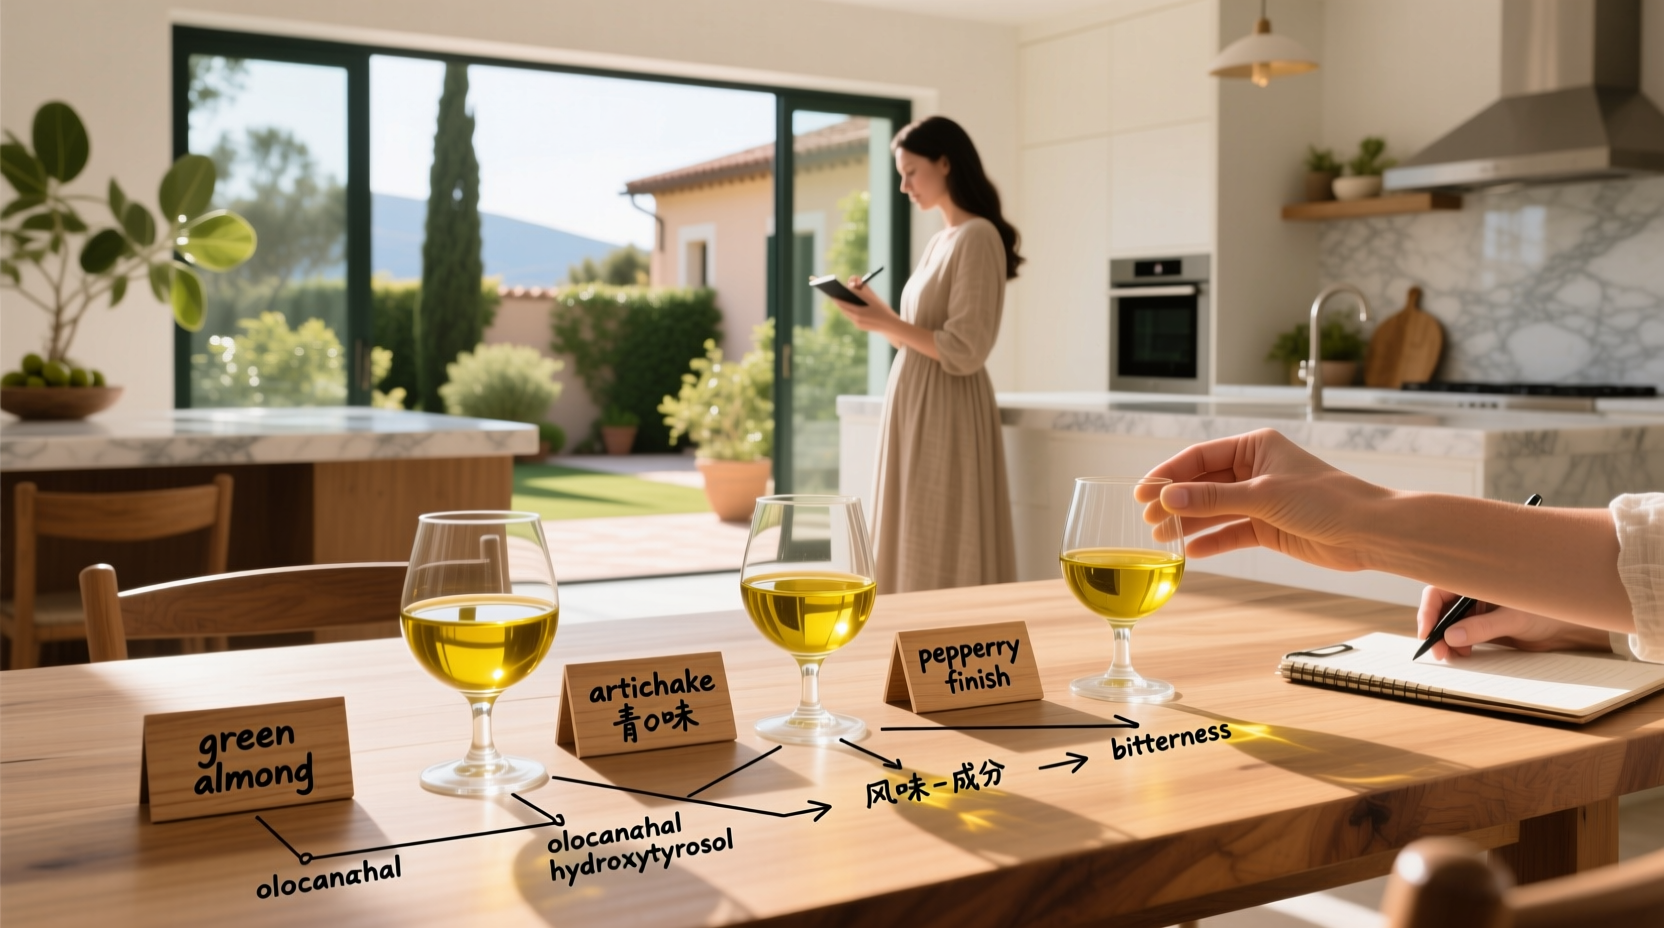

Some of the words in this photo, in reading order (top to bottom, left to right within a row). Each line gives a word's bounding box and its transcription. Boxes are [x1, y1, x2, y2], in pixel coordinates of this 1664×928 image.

[918, 638, 1020, 674] pepperry
[589, 668, 716, 703] artichake
[944, 664, 1011, 695] finish
[197, 725, 295, 769] green
[193, 751, 314, 796] almond
